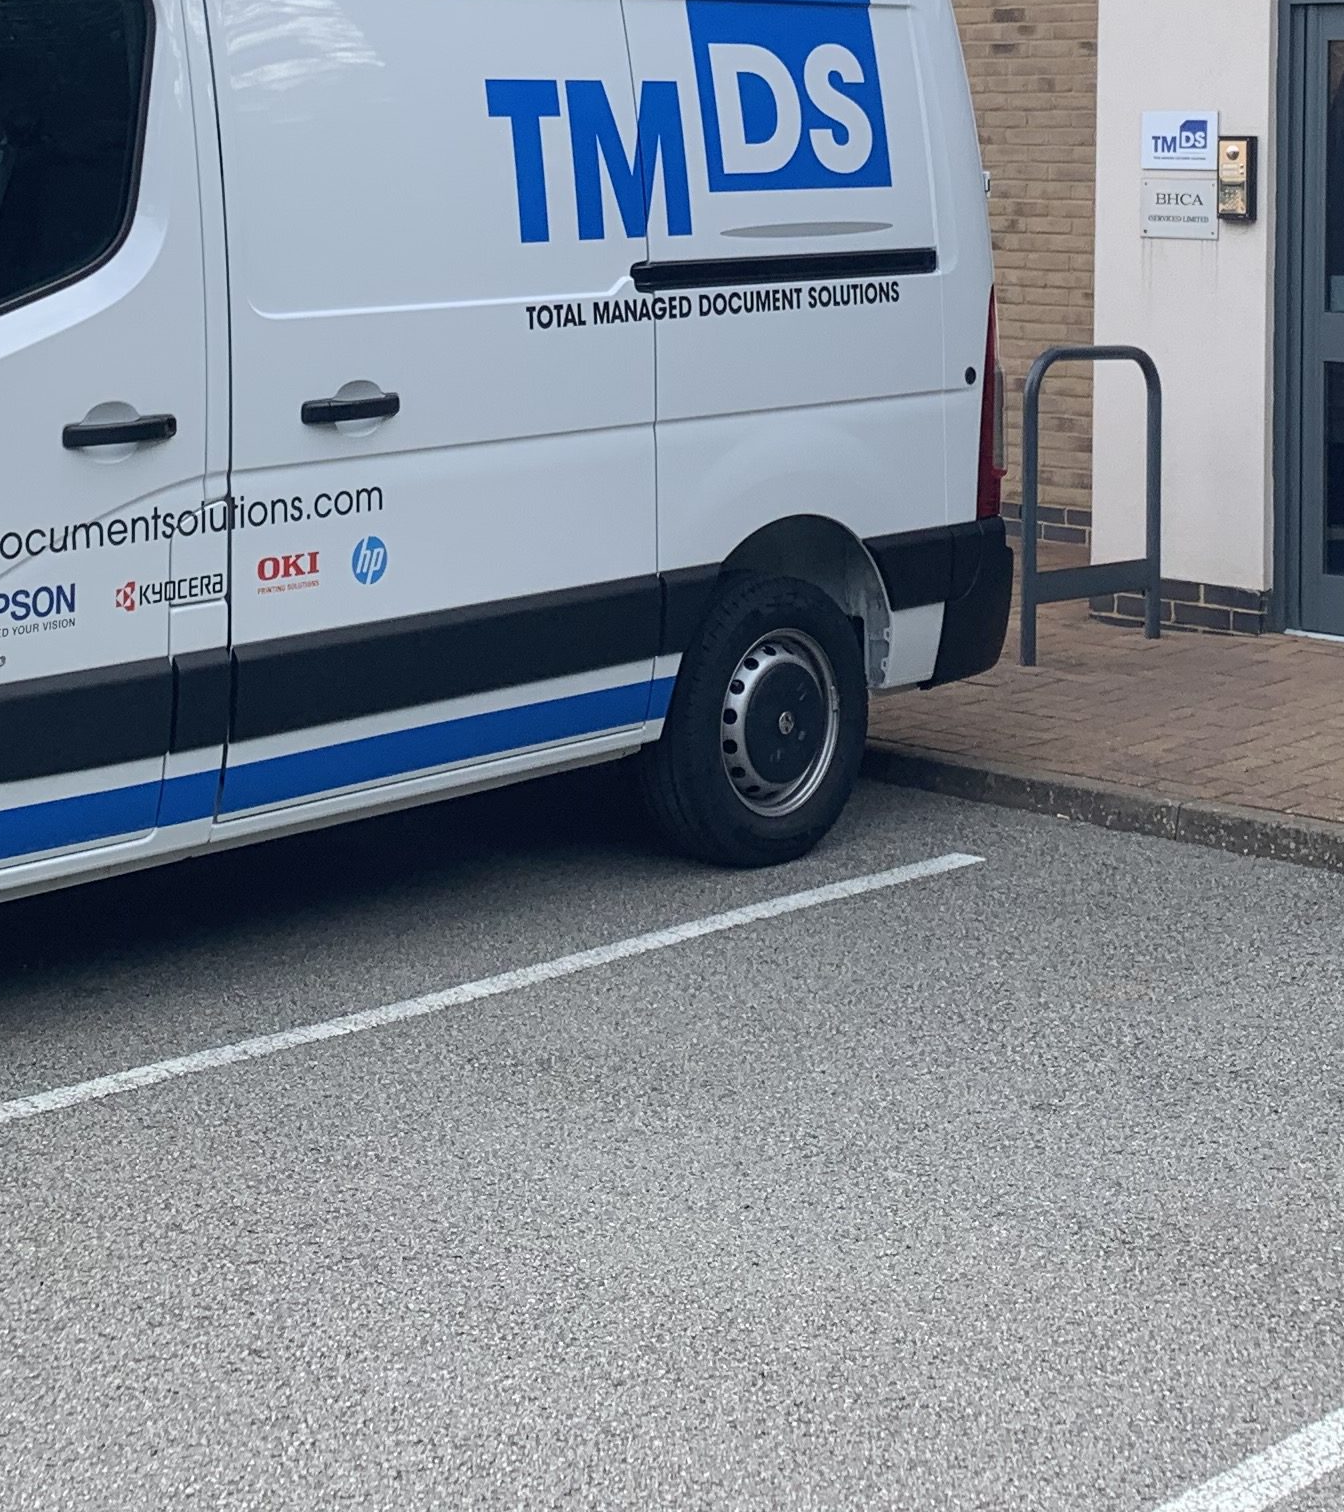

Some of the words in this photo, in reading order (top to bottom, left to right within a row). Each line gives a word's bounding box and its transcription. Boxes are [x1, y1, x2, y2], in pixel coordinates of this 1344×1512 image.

[485, 43, 873, 243] TMDS
[1152, 131, 1205, 153] TMDS
[1155, 193, 1204, 206] BHCA
[526, 303, 586, 330] TOTAL
[593, 295, 692, 325] MANAGED
[699, 287, 803, 317] DOCUMENT
[808, 281, 900, 309] SOLUTIONS
[257, 551, 320, 581] OKI
[355, 537, 385, 585] hp
[139, 573, 223, 607] KYOCERA
[12, 622, 40, 636] YOUR
[42, 618, 76, 632] VISION
